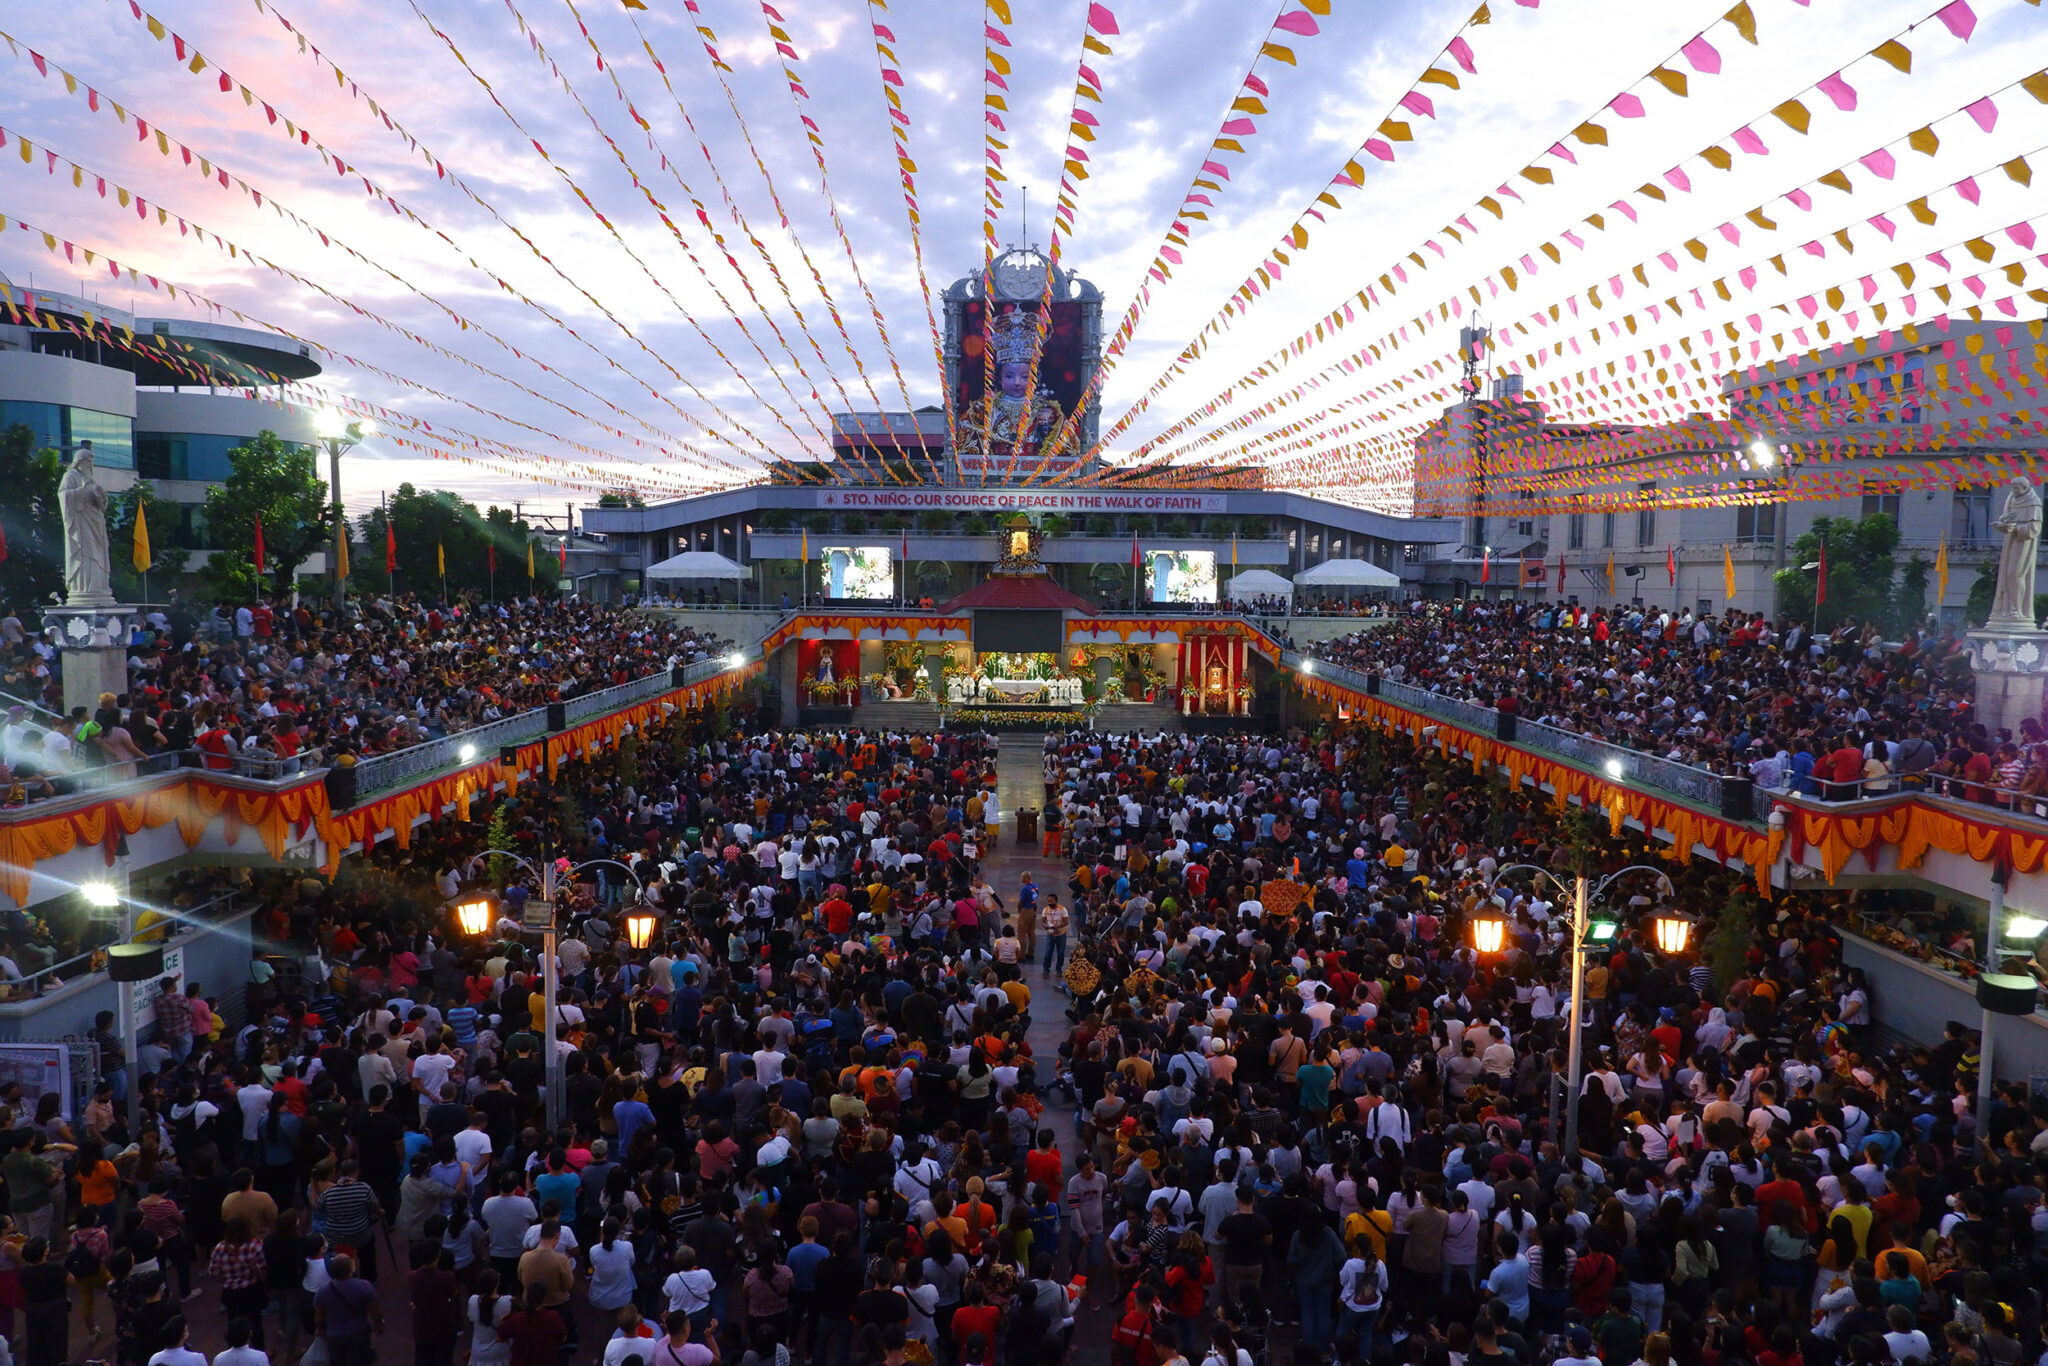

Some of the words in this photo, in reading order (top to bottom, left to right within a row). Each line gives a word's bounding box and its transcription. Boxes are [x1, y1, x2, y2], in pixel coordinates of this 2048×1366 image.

[961, 458, 994, 470] VIVA
[843, 493, 871, 505] STO.
[874, 491, 911, 505] NIÑO:
[914, 494, 942, 505] OUR
[945, 494, 995, 506] SOURCE
[998, 495, 1017, 506] OF
[1018, 495, 1057, 507] PEACE
[1060, 496, 1074, 507] IN
[1077, 496, 1101, 508] THE
[1104, 497, 1142, 508] WALK
[1145, 497, 1162, 508] OF
[1165, 497, 1201, 509] FAITH
